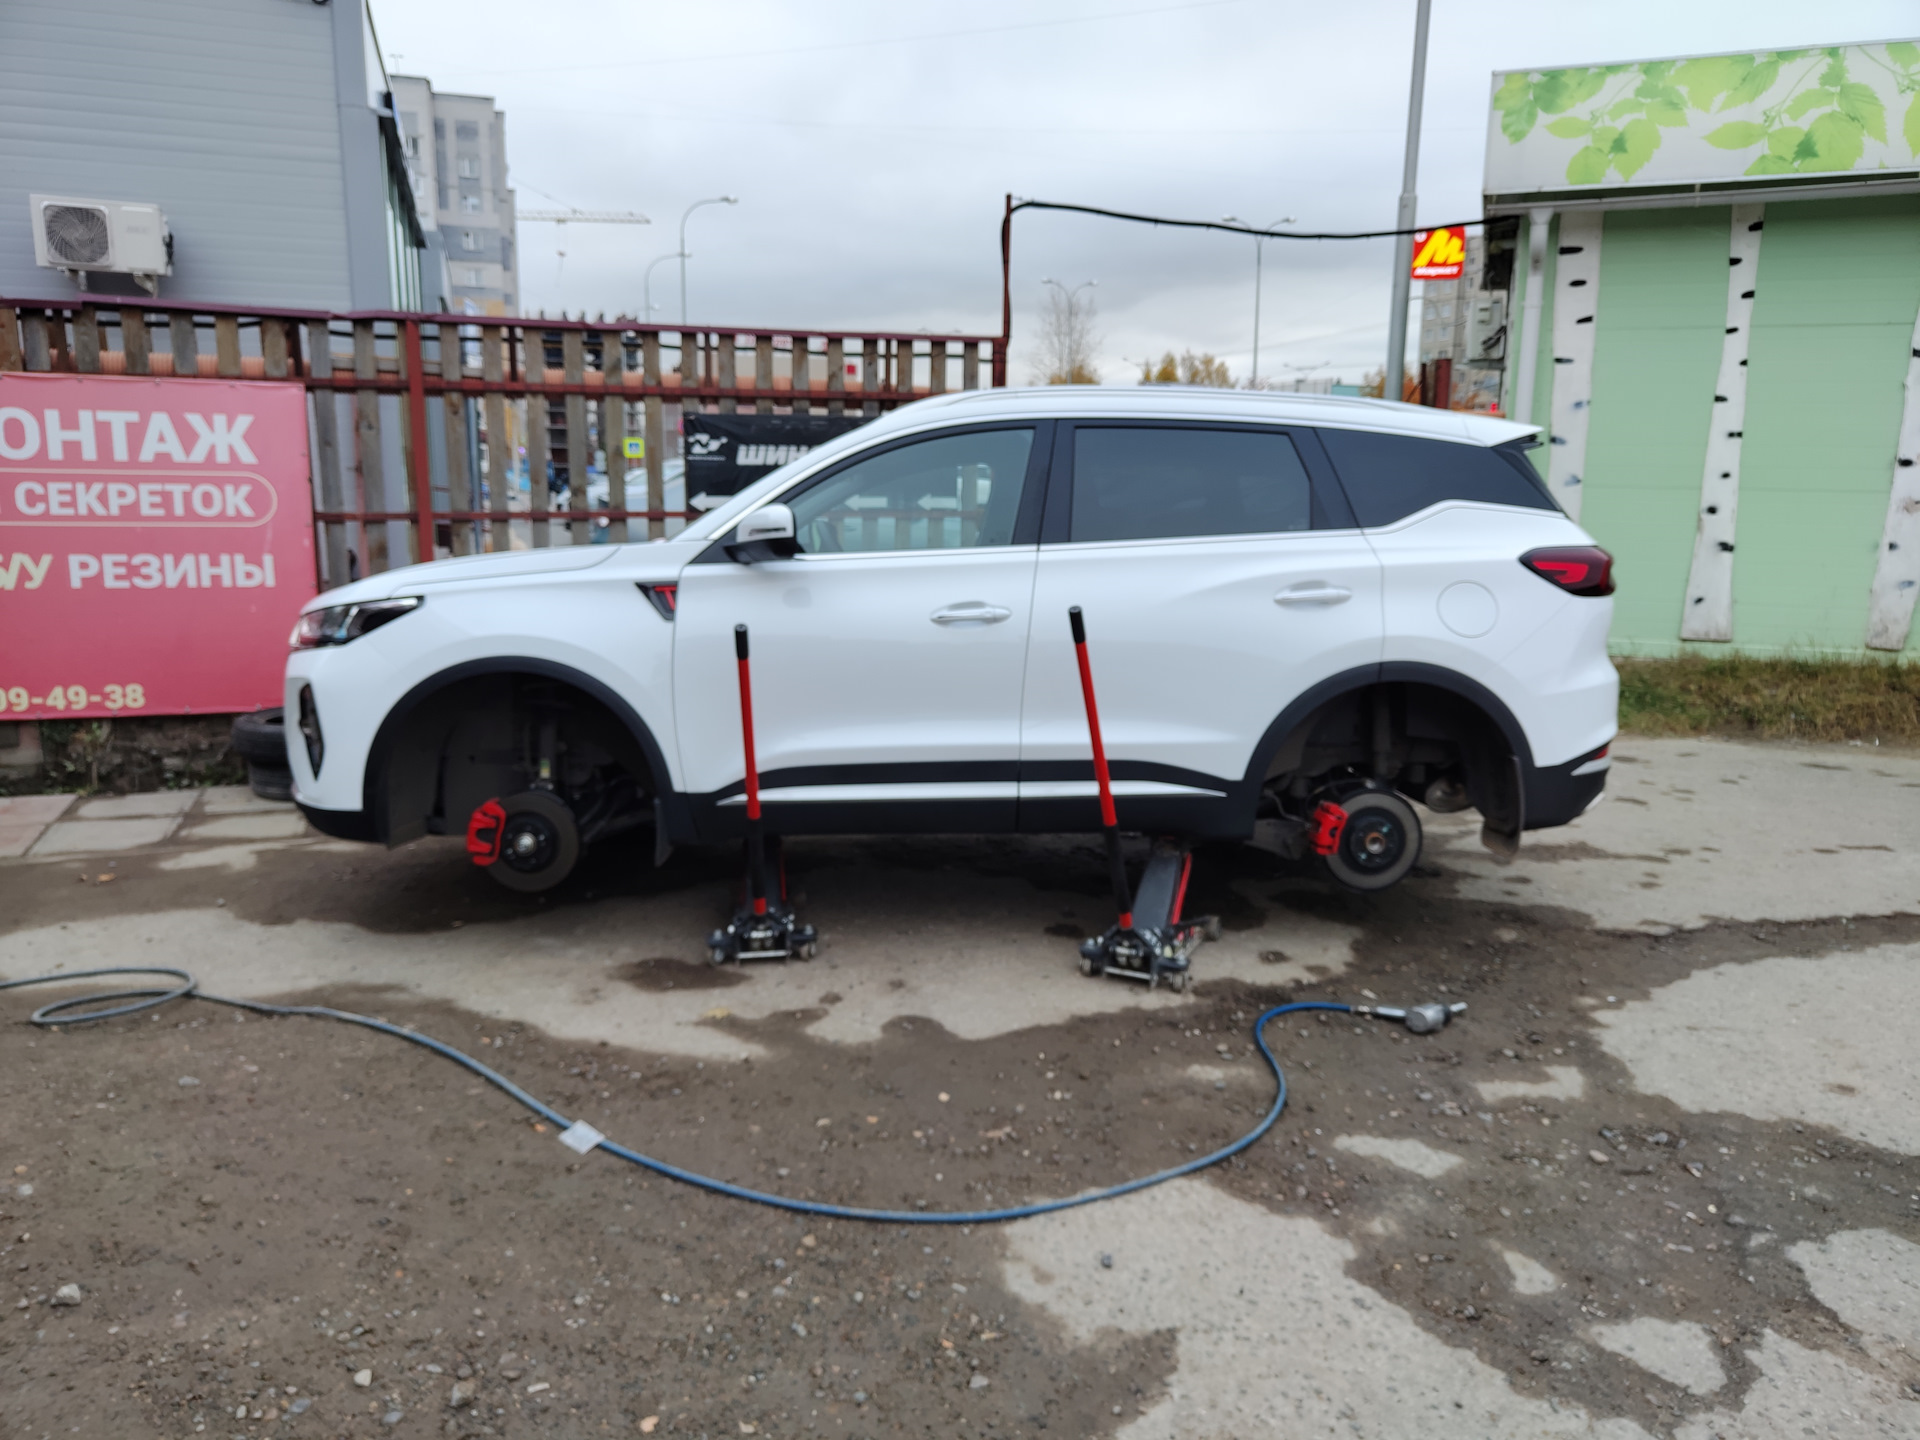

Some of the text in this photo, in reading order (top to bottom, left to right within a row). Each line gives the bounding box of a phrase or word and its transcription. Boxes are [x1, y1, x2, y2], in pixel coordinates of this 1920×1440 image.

[0, 407, 259, 464] ОНТАЖ
[736, 444, 815, 466] ШИН
[14, 481, 256, 517] СЕКРЕТОК
[0, 552, 276, 591] /У РЕЗИНЫ
